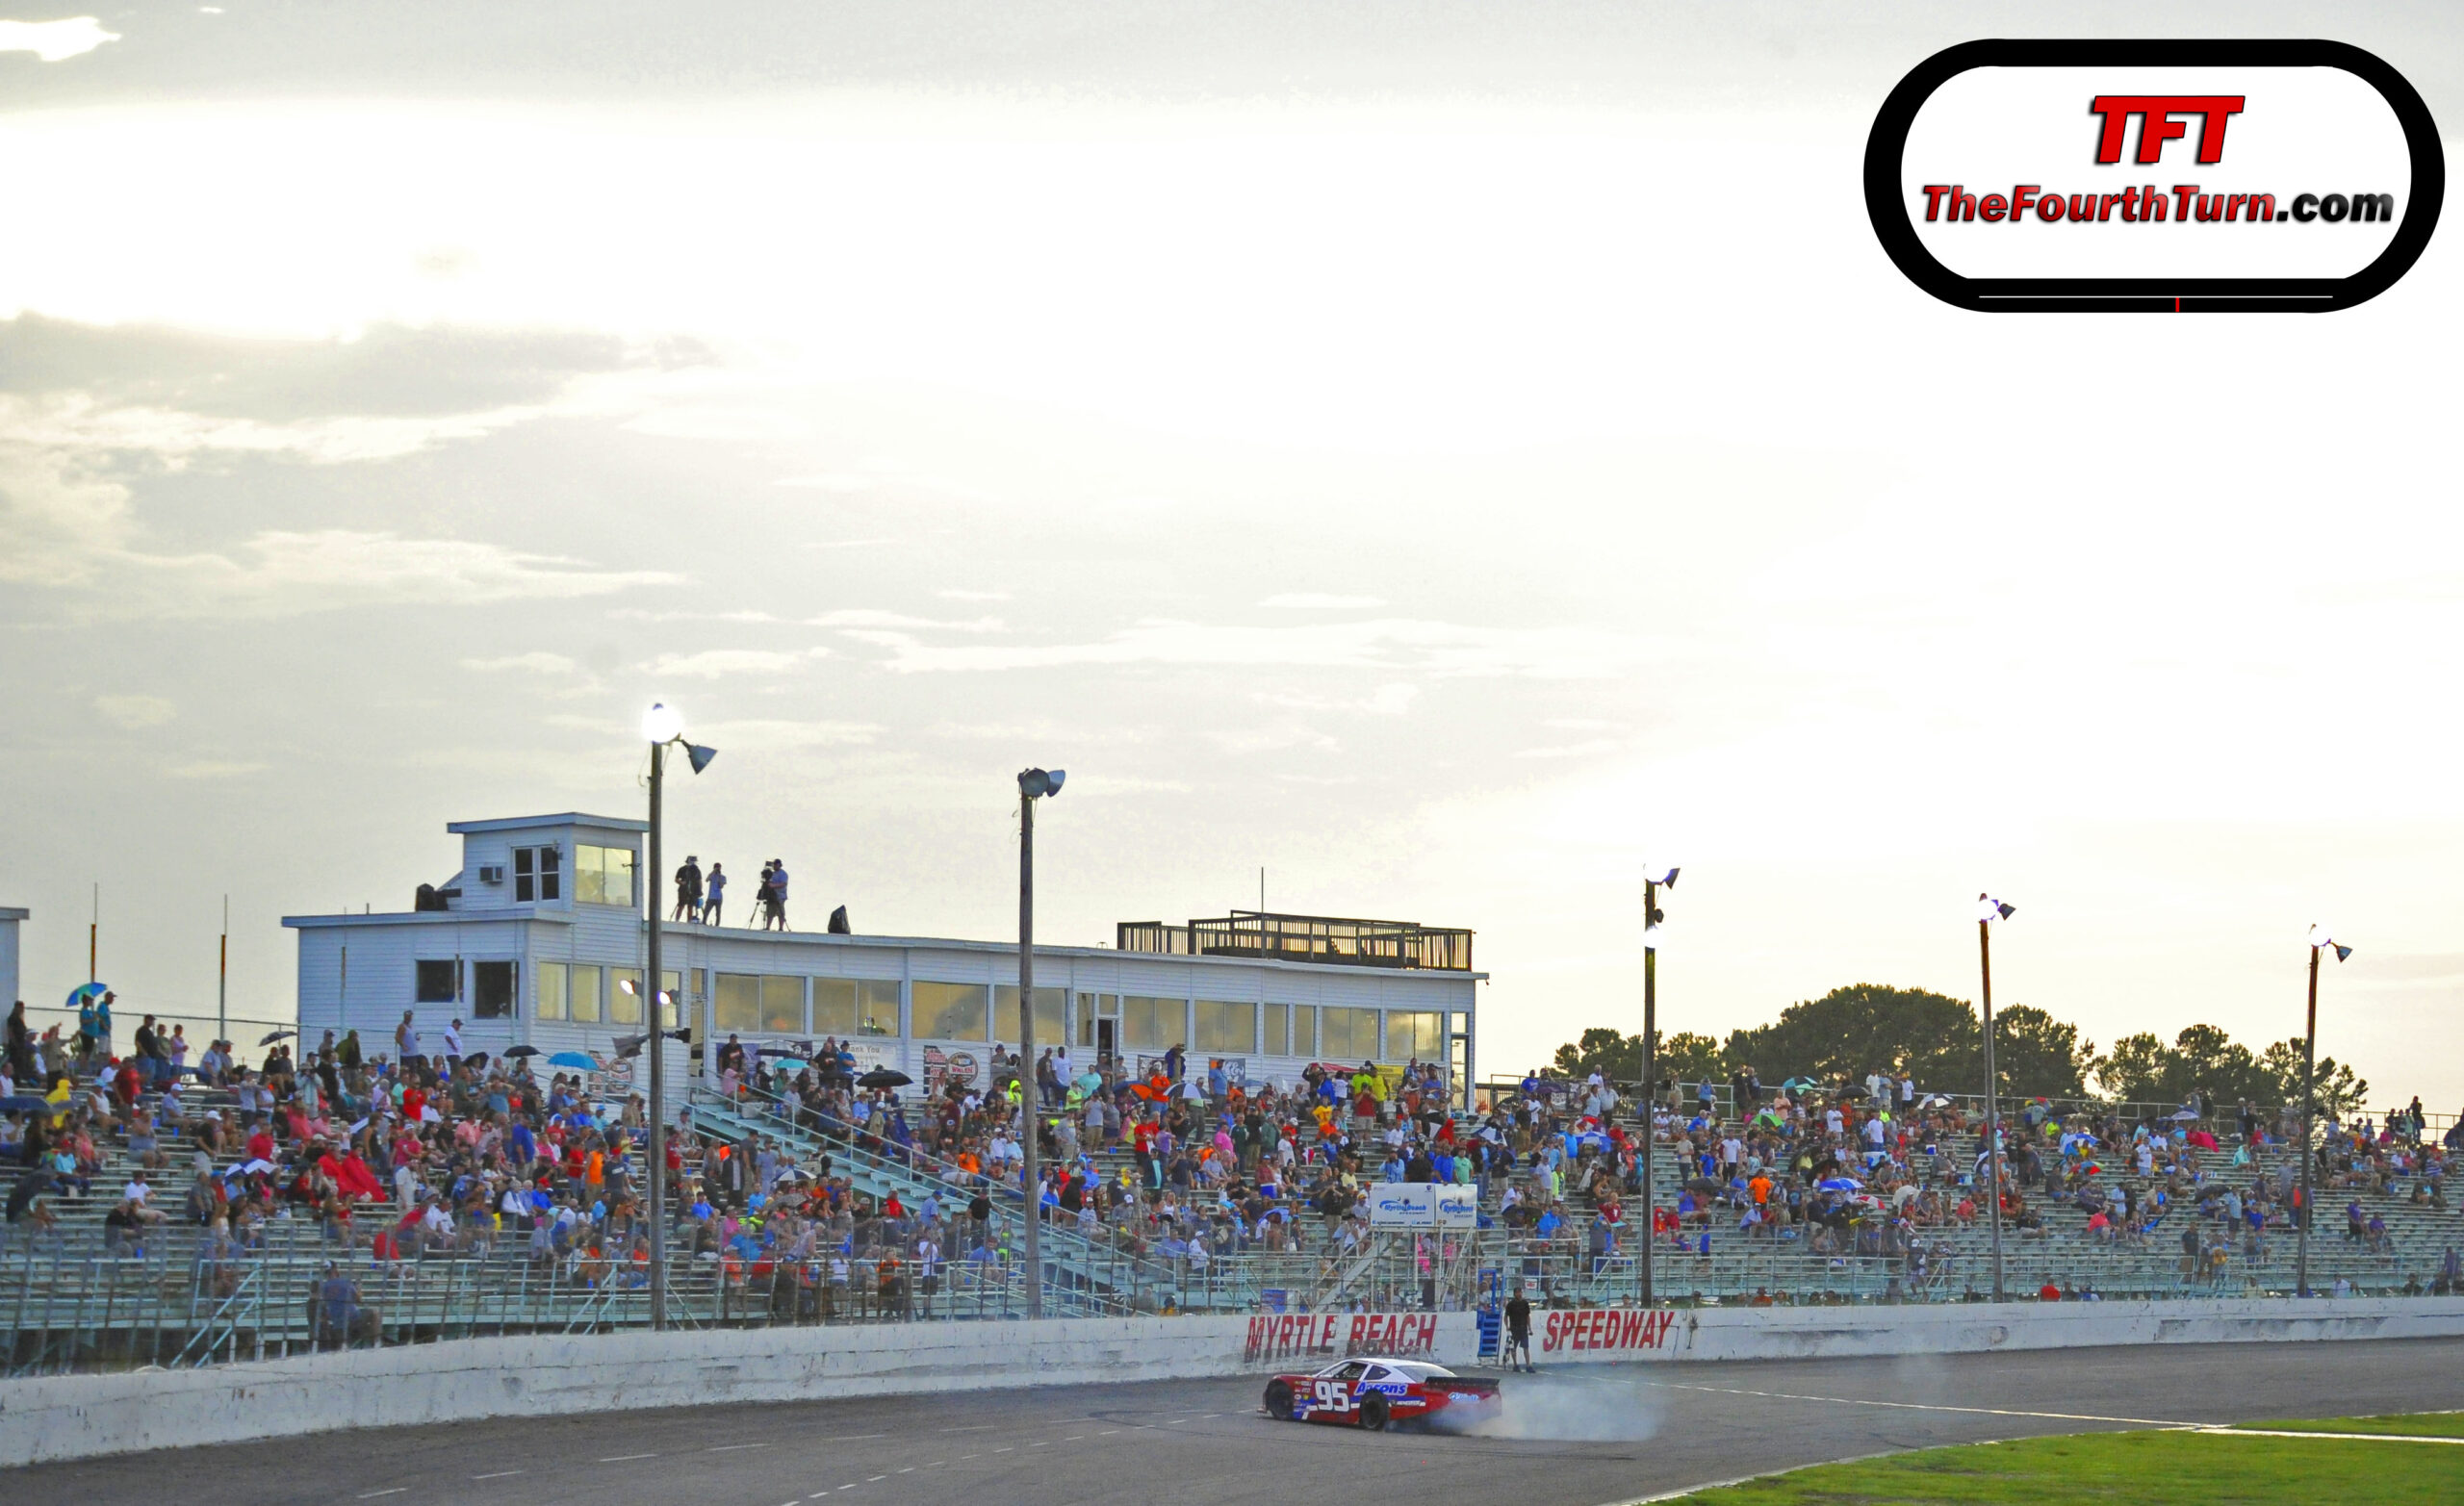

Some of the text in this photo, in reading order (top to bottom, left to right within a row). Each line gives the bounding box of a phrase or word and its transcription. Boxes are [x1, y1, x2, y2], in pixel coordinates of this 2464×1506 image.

[1245, 1311, 1675, 1363] MYRTLE BEACH SPEEDWAY
[1315, 1381, 1349, 1412] 95
